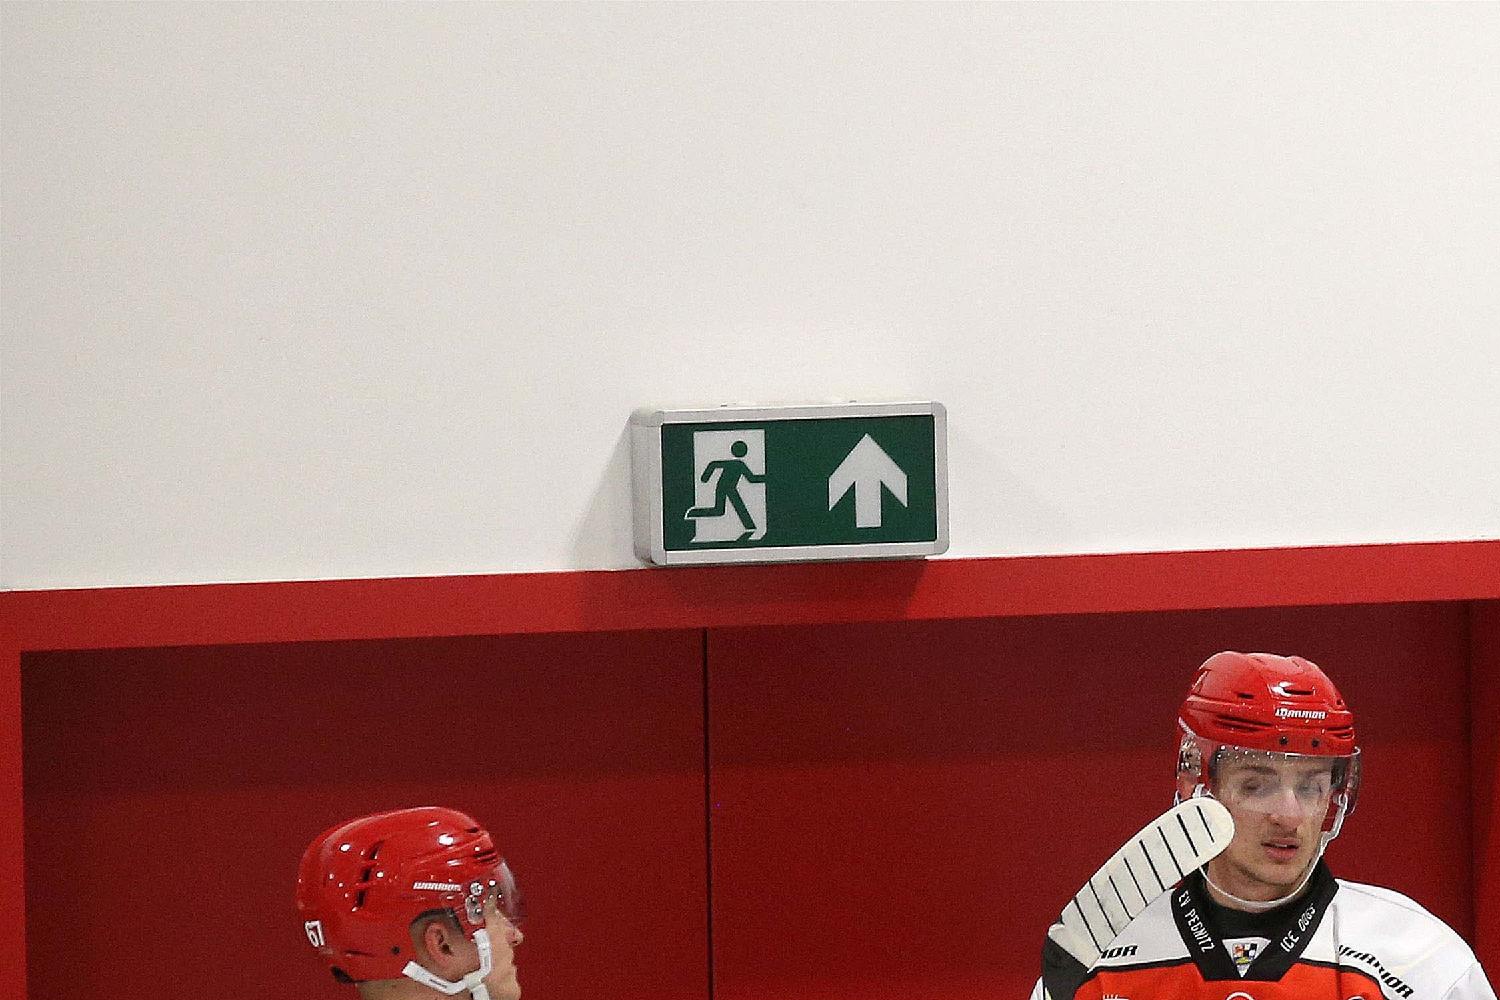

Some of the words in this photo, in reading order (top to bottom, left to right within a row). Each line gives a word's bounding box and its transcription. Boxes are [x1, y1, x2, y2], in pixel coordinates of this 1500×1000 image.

[1179, 890, 1192, 908] EV
[1185, 908, 1216, 953] PEGNITZ
[1280, 930, 1299, 952] ICE
